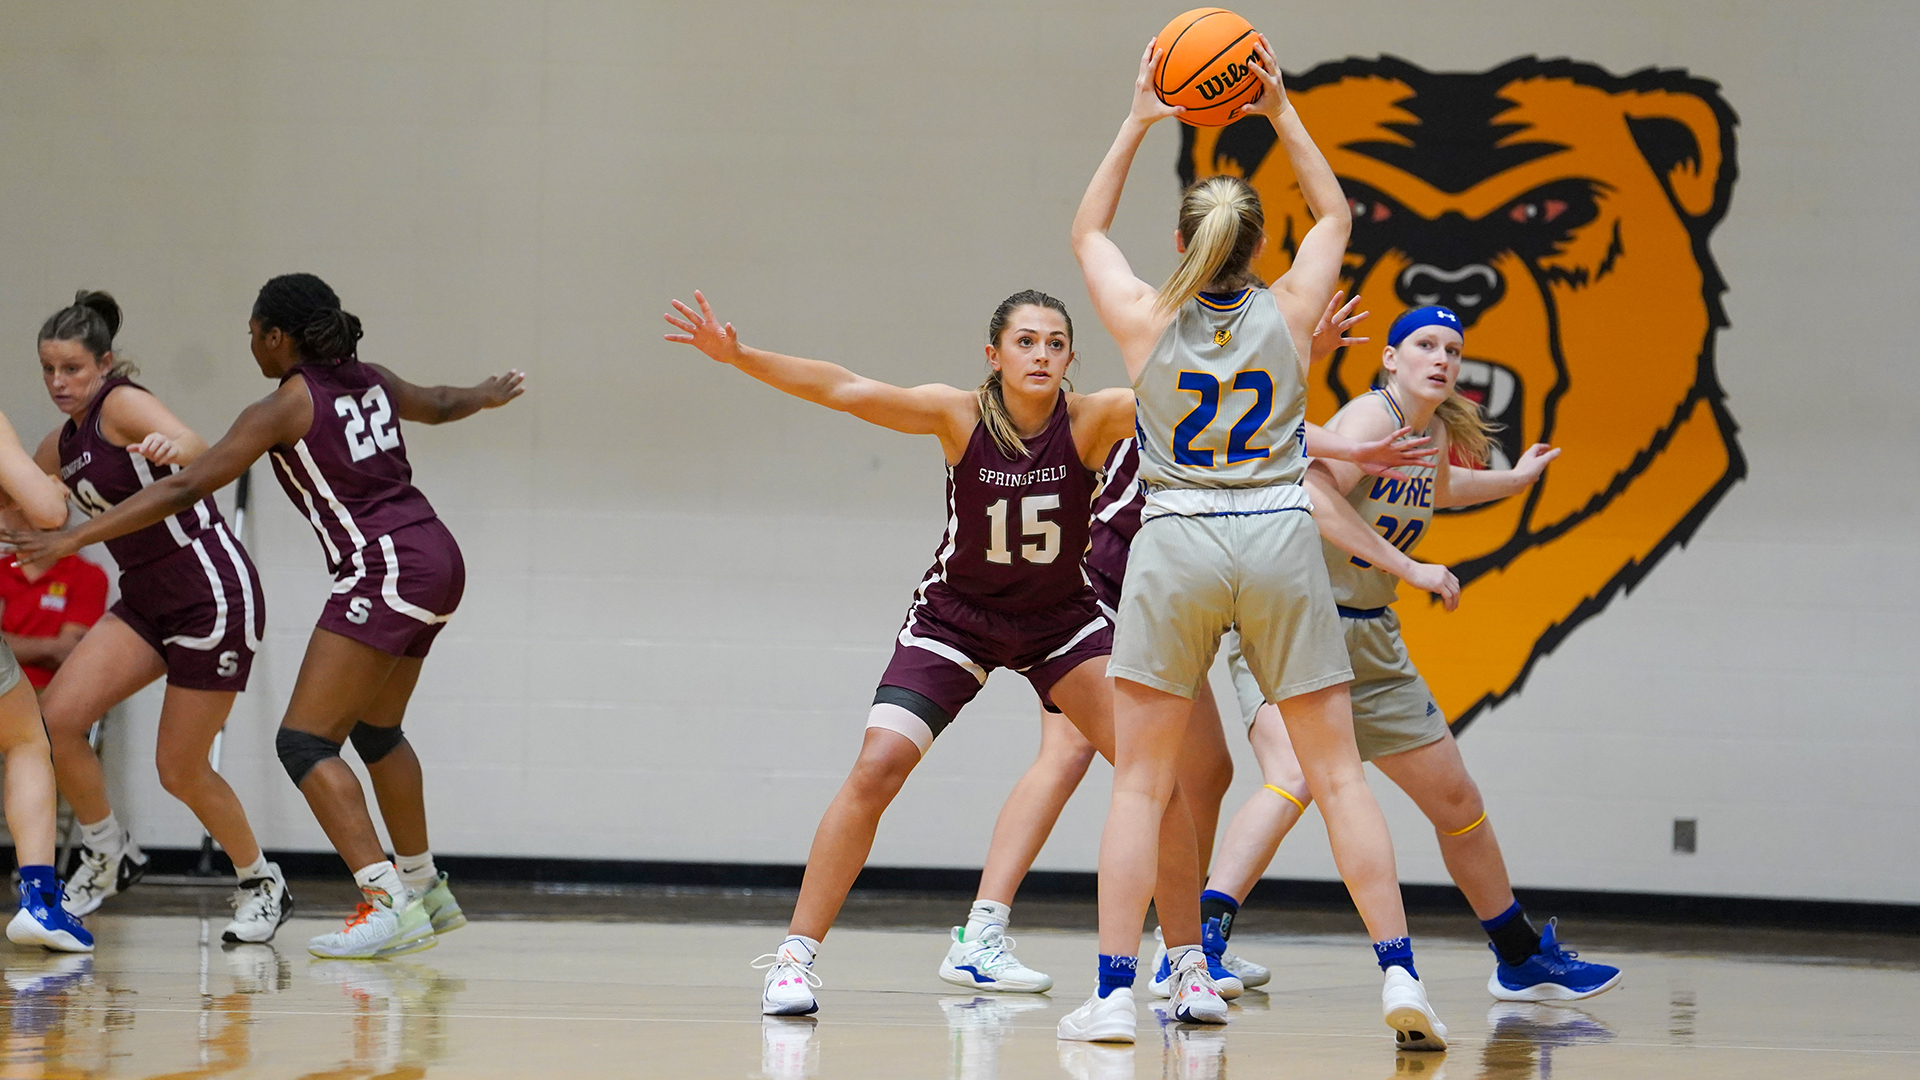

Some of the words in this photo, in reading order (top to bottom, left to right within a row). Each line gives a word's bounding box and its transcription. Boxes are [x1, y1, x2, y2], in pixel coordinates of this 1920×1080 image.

[334, 384, 400, 463] 22
[1171, 368, 1275, 468] 22
[978, 465, 1067, 487] SPRINGFIELD
[985, 493, 1062, 565] 15
[345, 596, 373, 625] S
[216, 650, 240, 677] S
